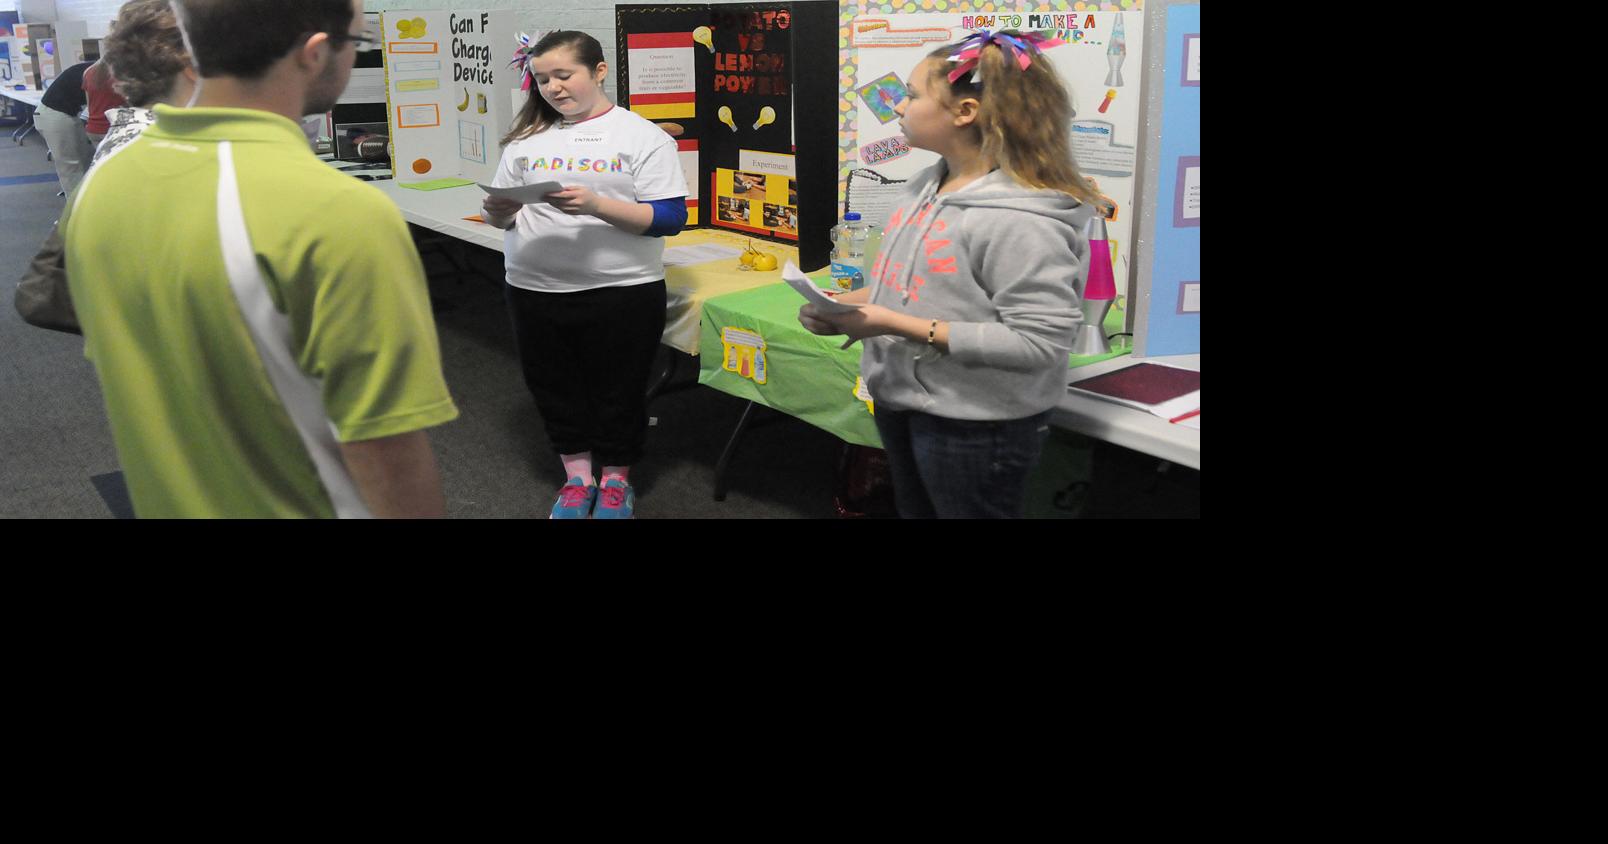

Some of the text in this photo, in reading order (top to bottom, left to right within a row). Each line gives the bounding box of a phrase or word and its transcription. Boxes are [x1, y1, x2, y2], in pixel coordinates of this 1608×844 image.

[449, 12, 489, 34] Can F
[962, 14, 1096, 30] HOW TO MAKE A
[451, 37, 492, 67] Charg
[714, 52, 785, 72] LEMON
[865, 138, 900, 156] LAVA
[865, 145, 910, 165] LAMPS
[752, 159, 788, 171] Experiment
